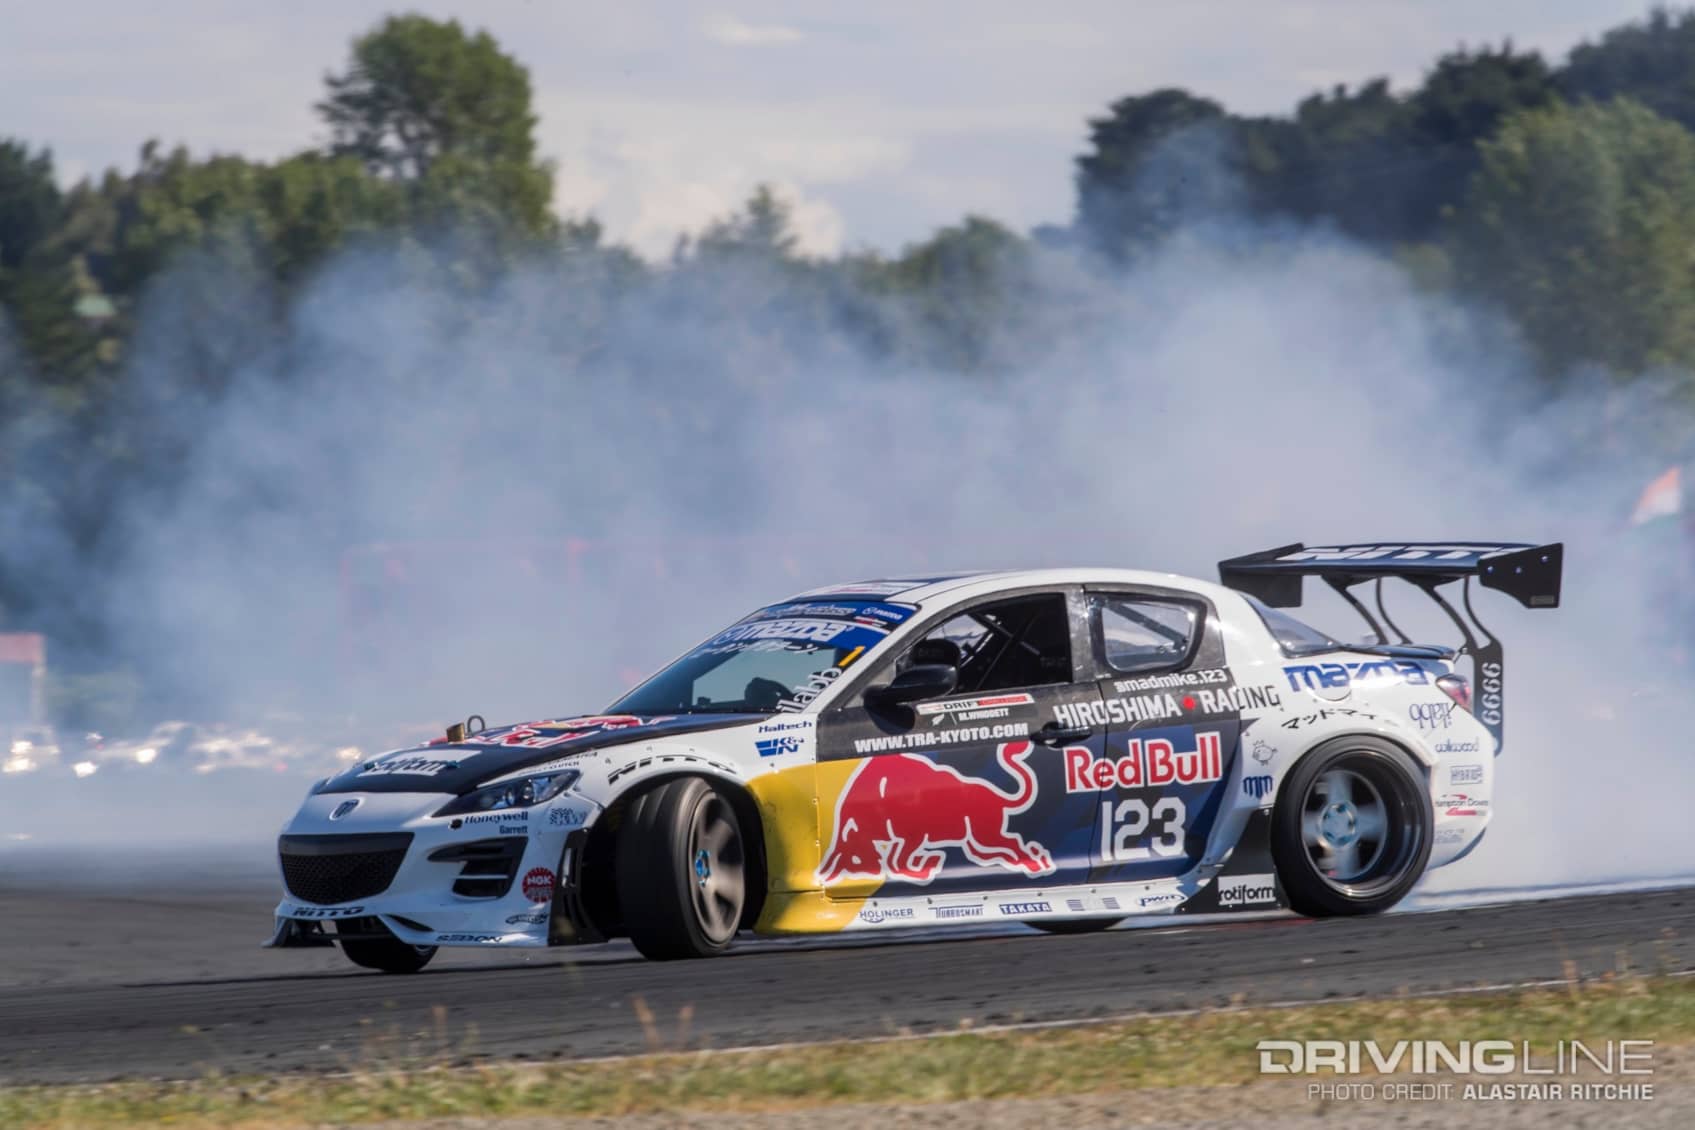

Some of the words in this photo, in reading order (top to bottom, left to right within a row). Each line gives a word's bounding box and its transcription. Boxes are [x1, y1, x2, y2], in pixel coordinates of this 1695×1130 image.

[1282, 661, 1429, 692] mazda
[1053, 694, 1182, 729] HIROSHIMA
[1198, 685, 1281, 713] RACING
[758, 721, 812, 733] Haltech
[854, 723, 1029, 752] WWW.TRA-KYOTO.COM
[1064, 739, 1144, 793] Red
[1145, 731, 1223, 786] Bull
[464, 811, 528, 825] Honeywell
[499, 825, 528, 834] Garrett
[1101, 797, 1186, 861] 123
[527, 875, 552, 885] NGK
[1218, 885, 1275, 905] rotiform
[292, 906, 364, 917] NITTO
[860, 908, 913, 919] HOLINGER
[1001, 903, 1050, 914] TAKATA
